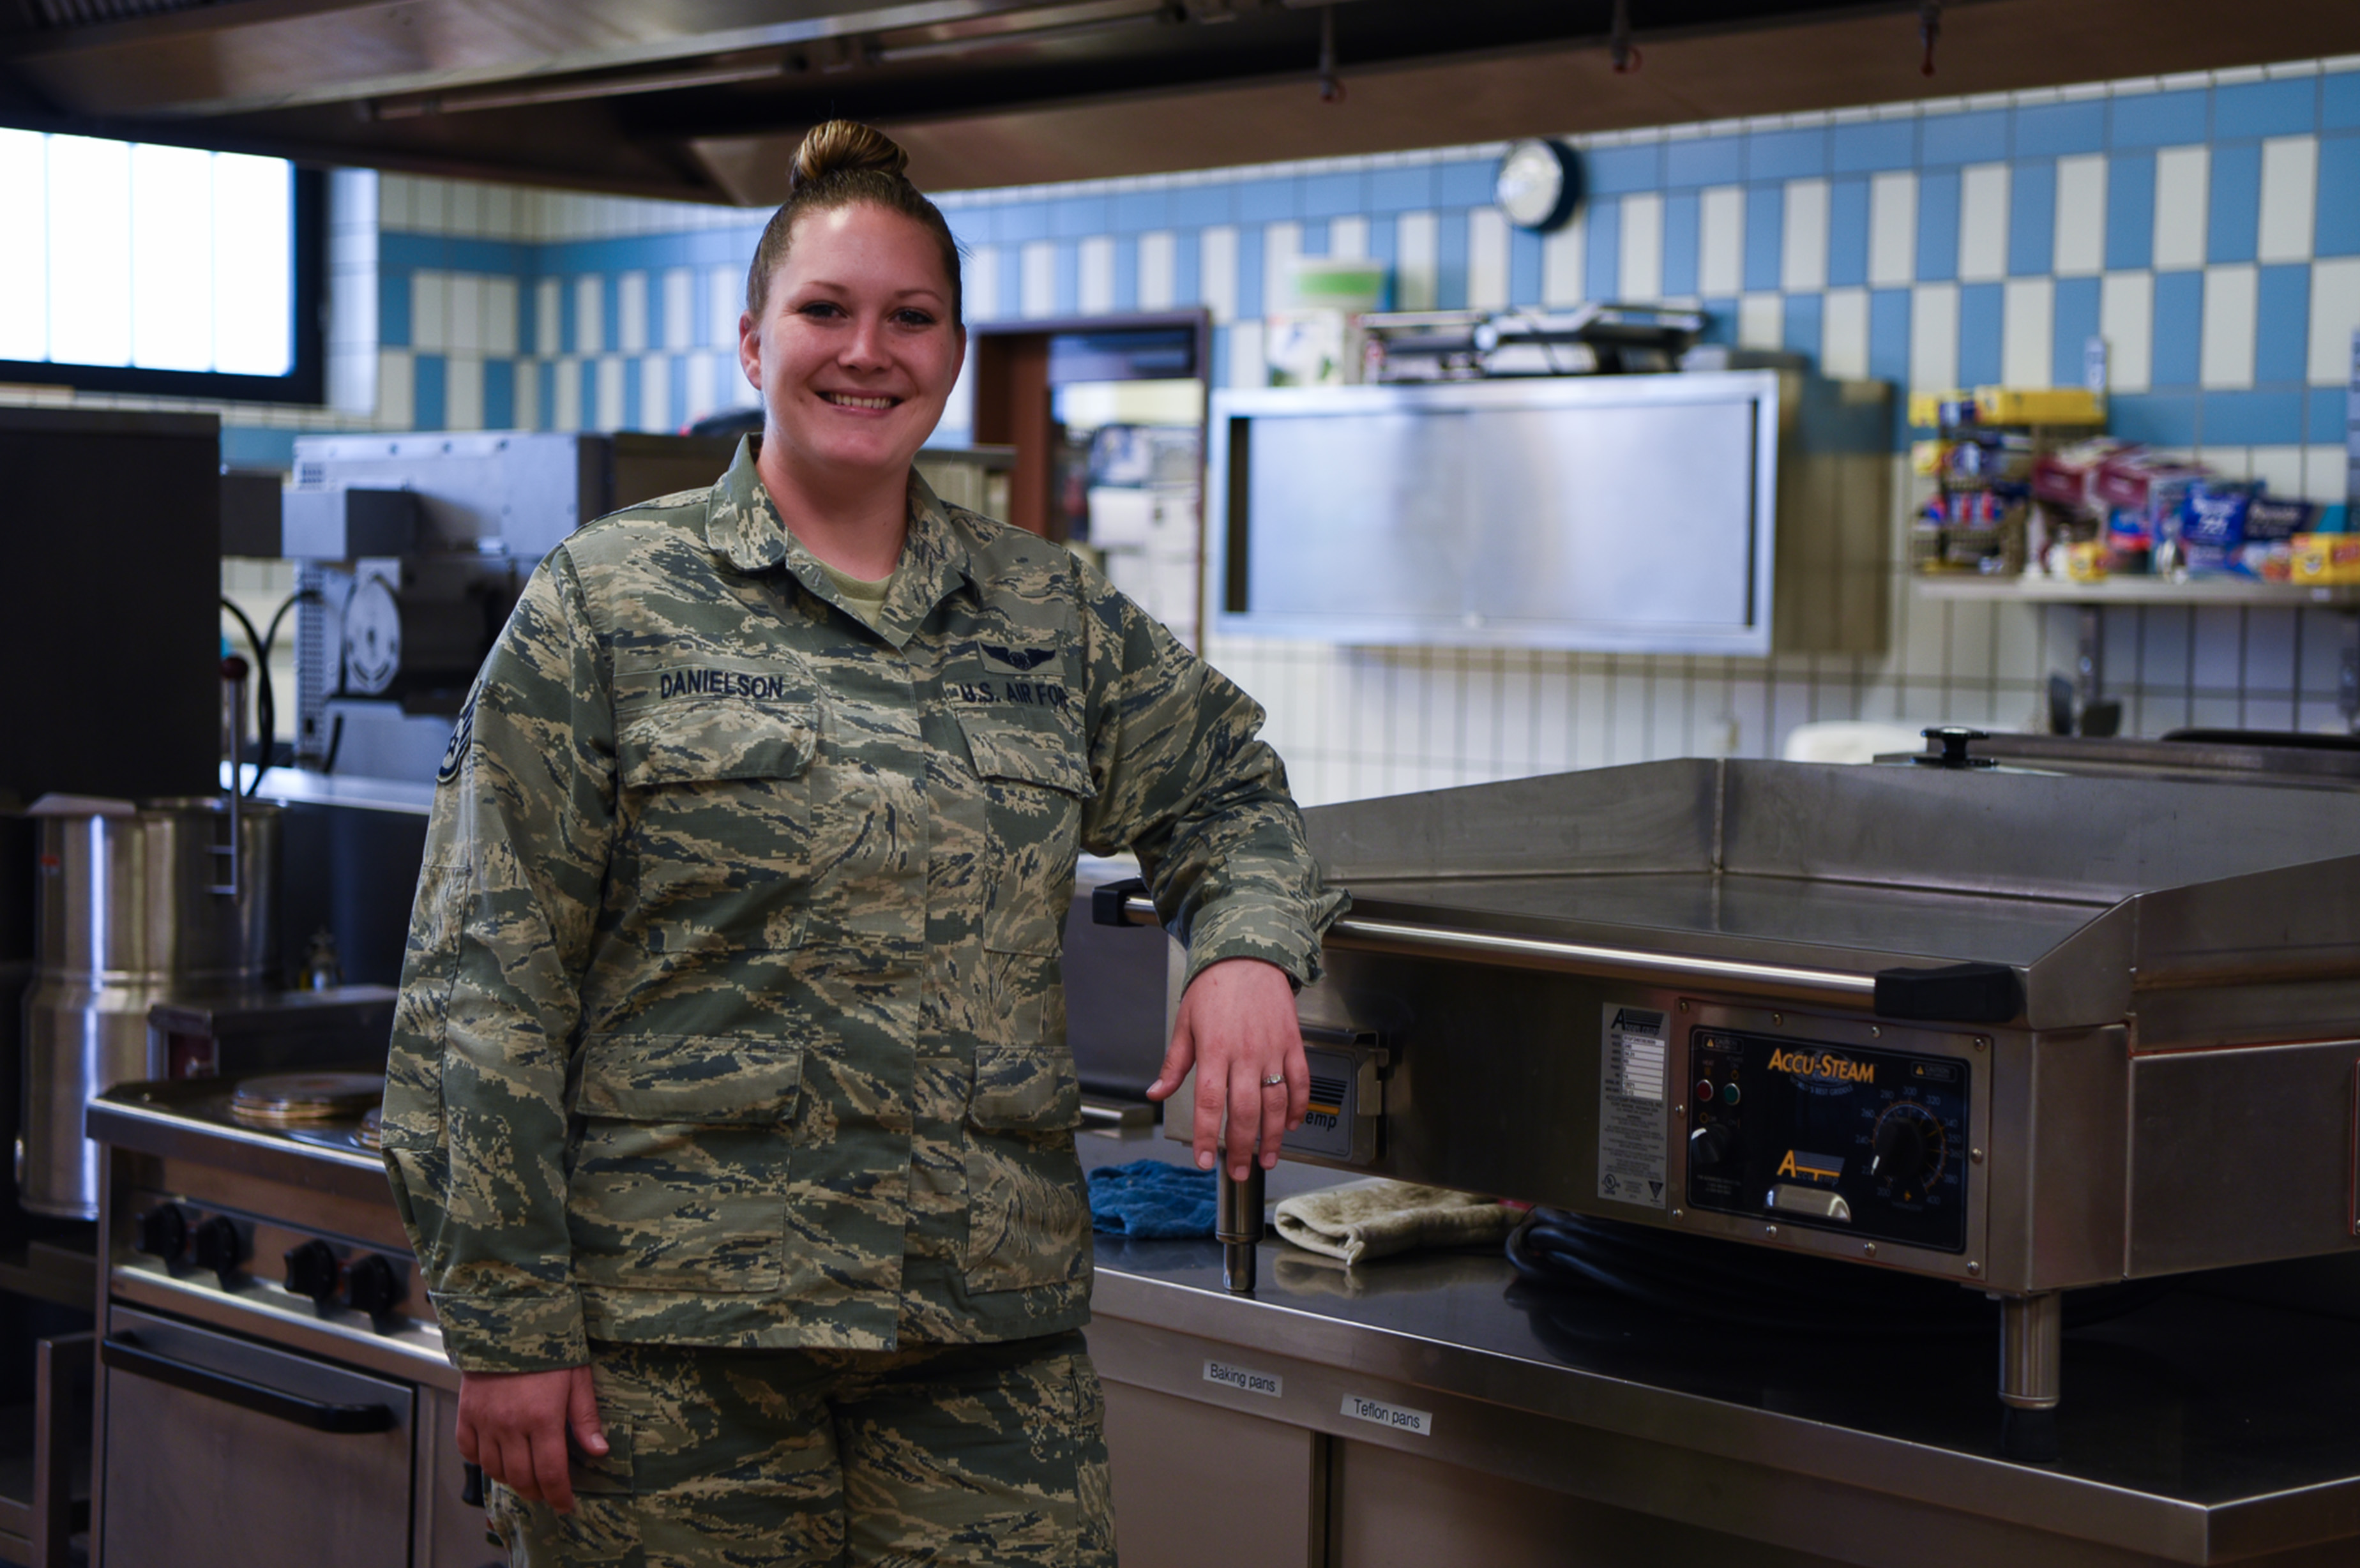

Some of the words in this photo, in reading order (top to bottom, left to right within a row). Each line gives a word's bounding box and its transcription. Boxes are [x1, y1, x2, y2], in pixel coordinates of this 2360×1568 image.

[661, 669, 783, 699] DANIELSON
[960, 682, 1001, 702] U.S.
[1006, 682, 1032, 704] AIR
[1767, 1047, 1875, 1084] ACCU-STEAM
[1880, 1089, 1895, 1100] 280
[1902, 1086, 1918, 1097] 300
[1926, 1095, 1942, 1106] 320
[1861, 1108, 1876, 1119] 260
[1944, 1118, 1959, 1129] 340
[1854, 1135, 1870, 1145] 240
[1947, 1133, 1963, 1144] 350
[1776, 1148, 1841, 1187] AccuTemp
[1861, 1165, 1873, 1175] 22
[1876, 1186, 1892, 1198] 200
[1926, 1195, 1942, 1206] 400
[1210, 1363, 1246, 1387] Baking
[1249, 1375, 1276, 1392] pans
[1354, 1398, 1389, 1422] Teflon
[1392, 1411, 1420, 1429] pans
